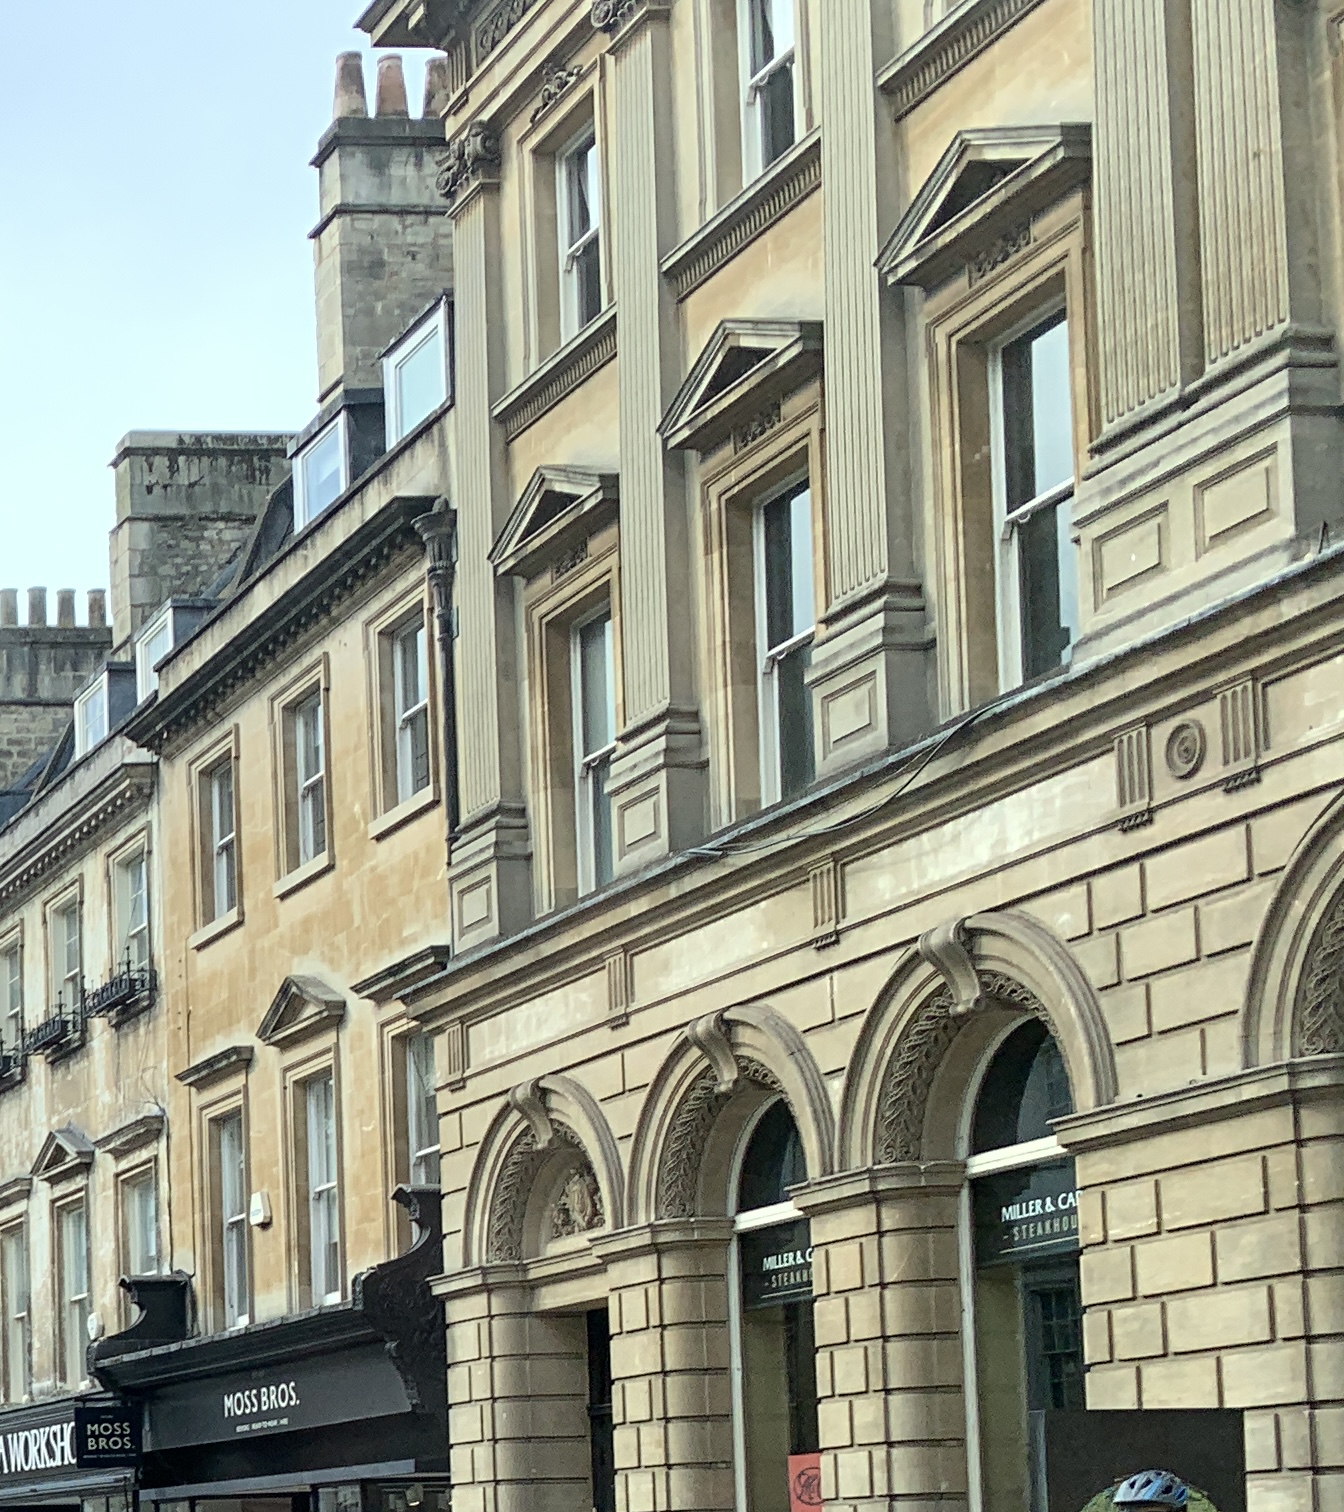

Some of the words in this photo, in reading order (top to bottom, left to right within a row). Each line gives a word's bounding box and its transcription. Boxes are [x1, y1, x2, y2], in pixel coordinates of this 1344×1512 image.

[1001, 1199, 1043, 1222] MILLER
[1045, 1196, 1056, 1213] &
[762, 1252, 795, 1271] MILLER
[796, 1250, 805, 1264] &
[224, 1389, 258, 1418] MOSS
[260, 1381, 300, 1411] BROS.
[86, 1422, 130, 1436] MOSS
[88, 1436, 136, 1451] BROS.
